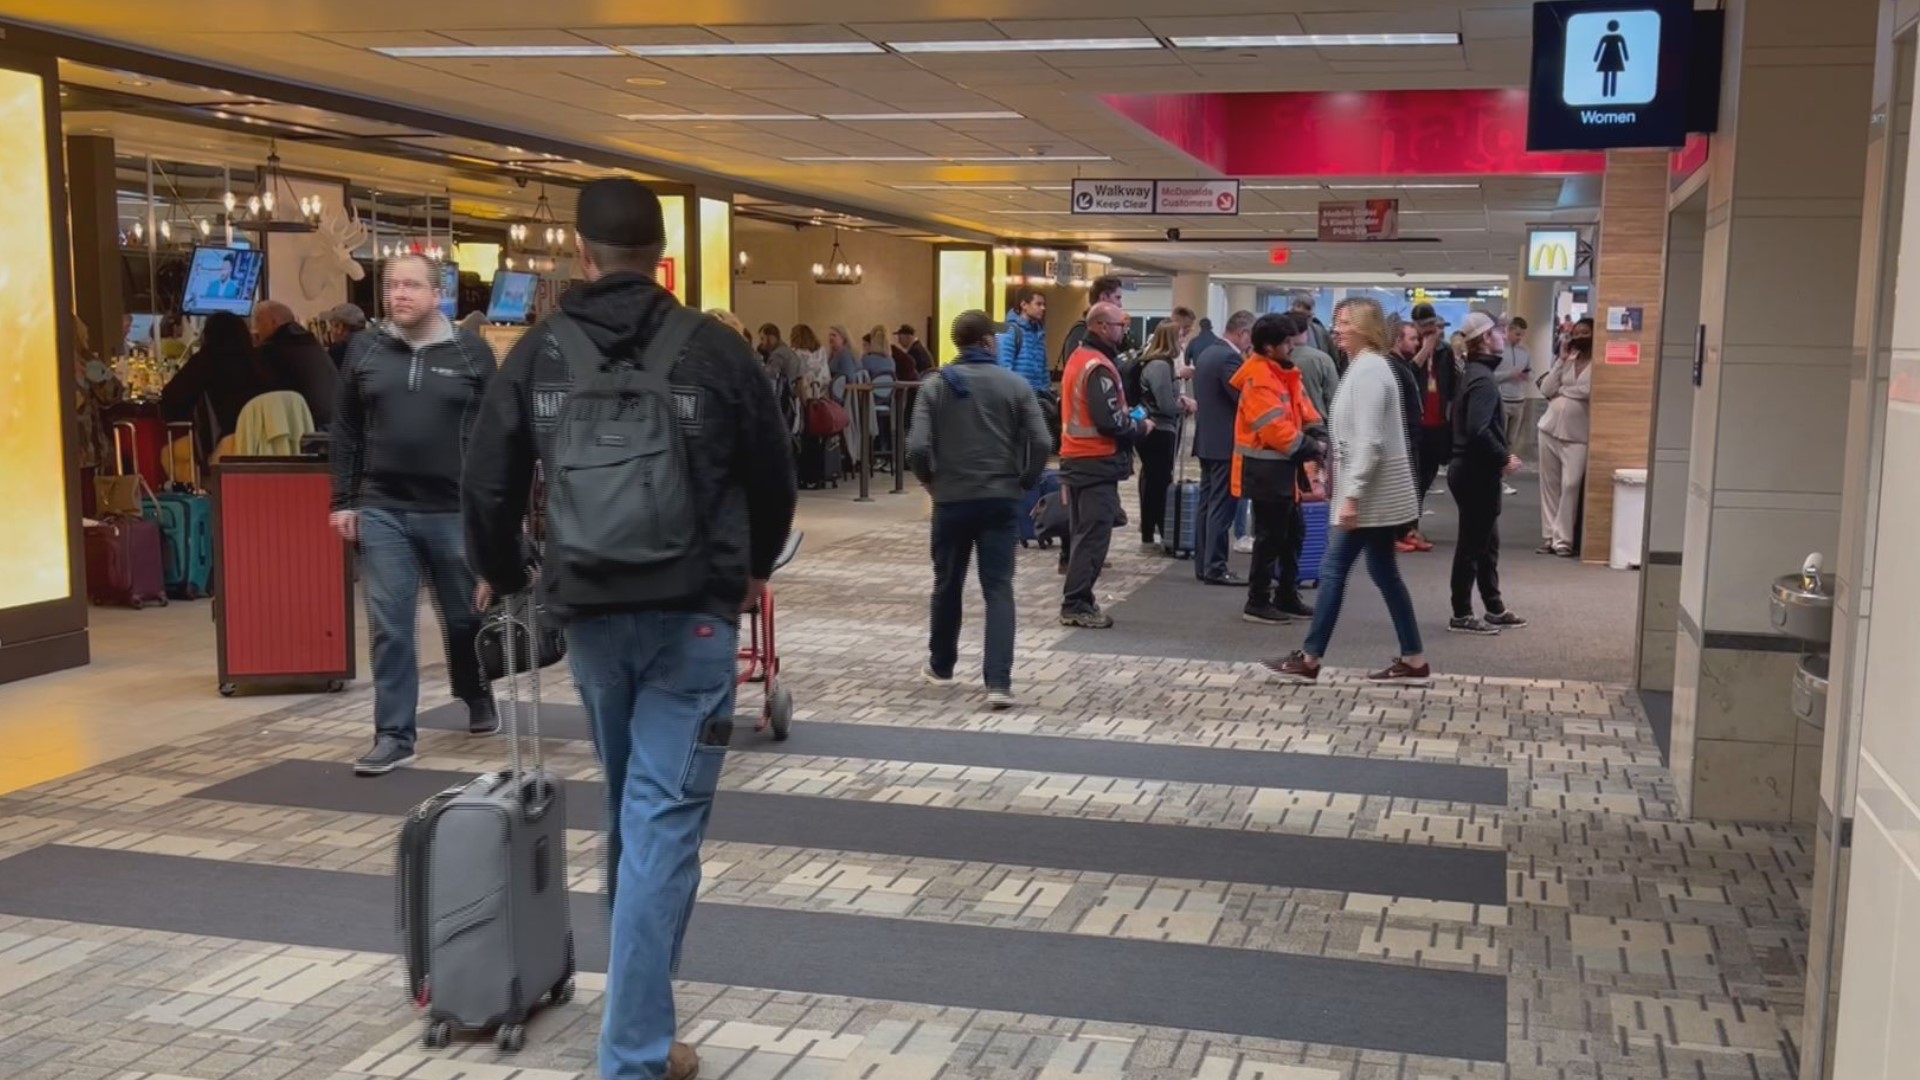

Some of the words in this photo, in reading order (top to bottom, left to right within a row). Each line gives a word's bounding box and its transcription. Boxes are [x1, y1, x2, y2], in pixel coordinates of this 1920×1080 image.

[1580, 110, 1636, 124] Women
[1094, 184, 1151, 199] Walkway
[1161, 187, 1213, 196] McDonalds
[1095, 200, 1121, 210] Keep
[1123, 199, 1148, 209] Clear
[1161, 199, 1213, 208] Customers
[1322, 209, 1351, 217] Mobile
[1353, 208, 1378, 217] Order
[1355, 217, 1379, 226] Order
[1332, 226, 1367, 235] Pick-Up
